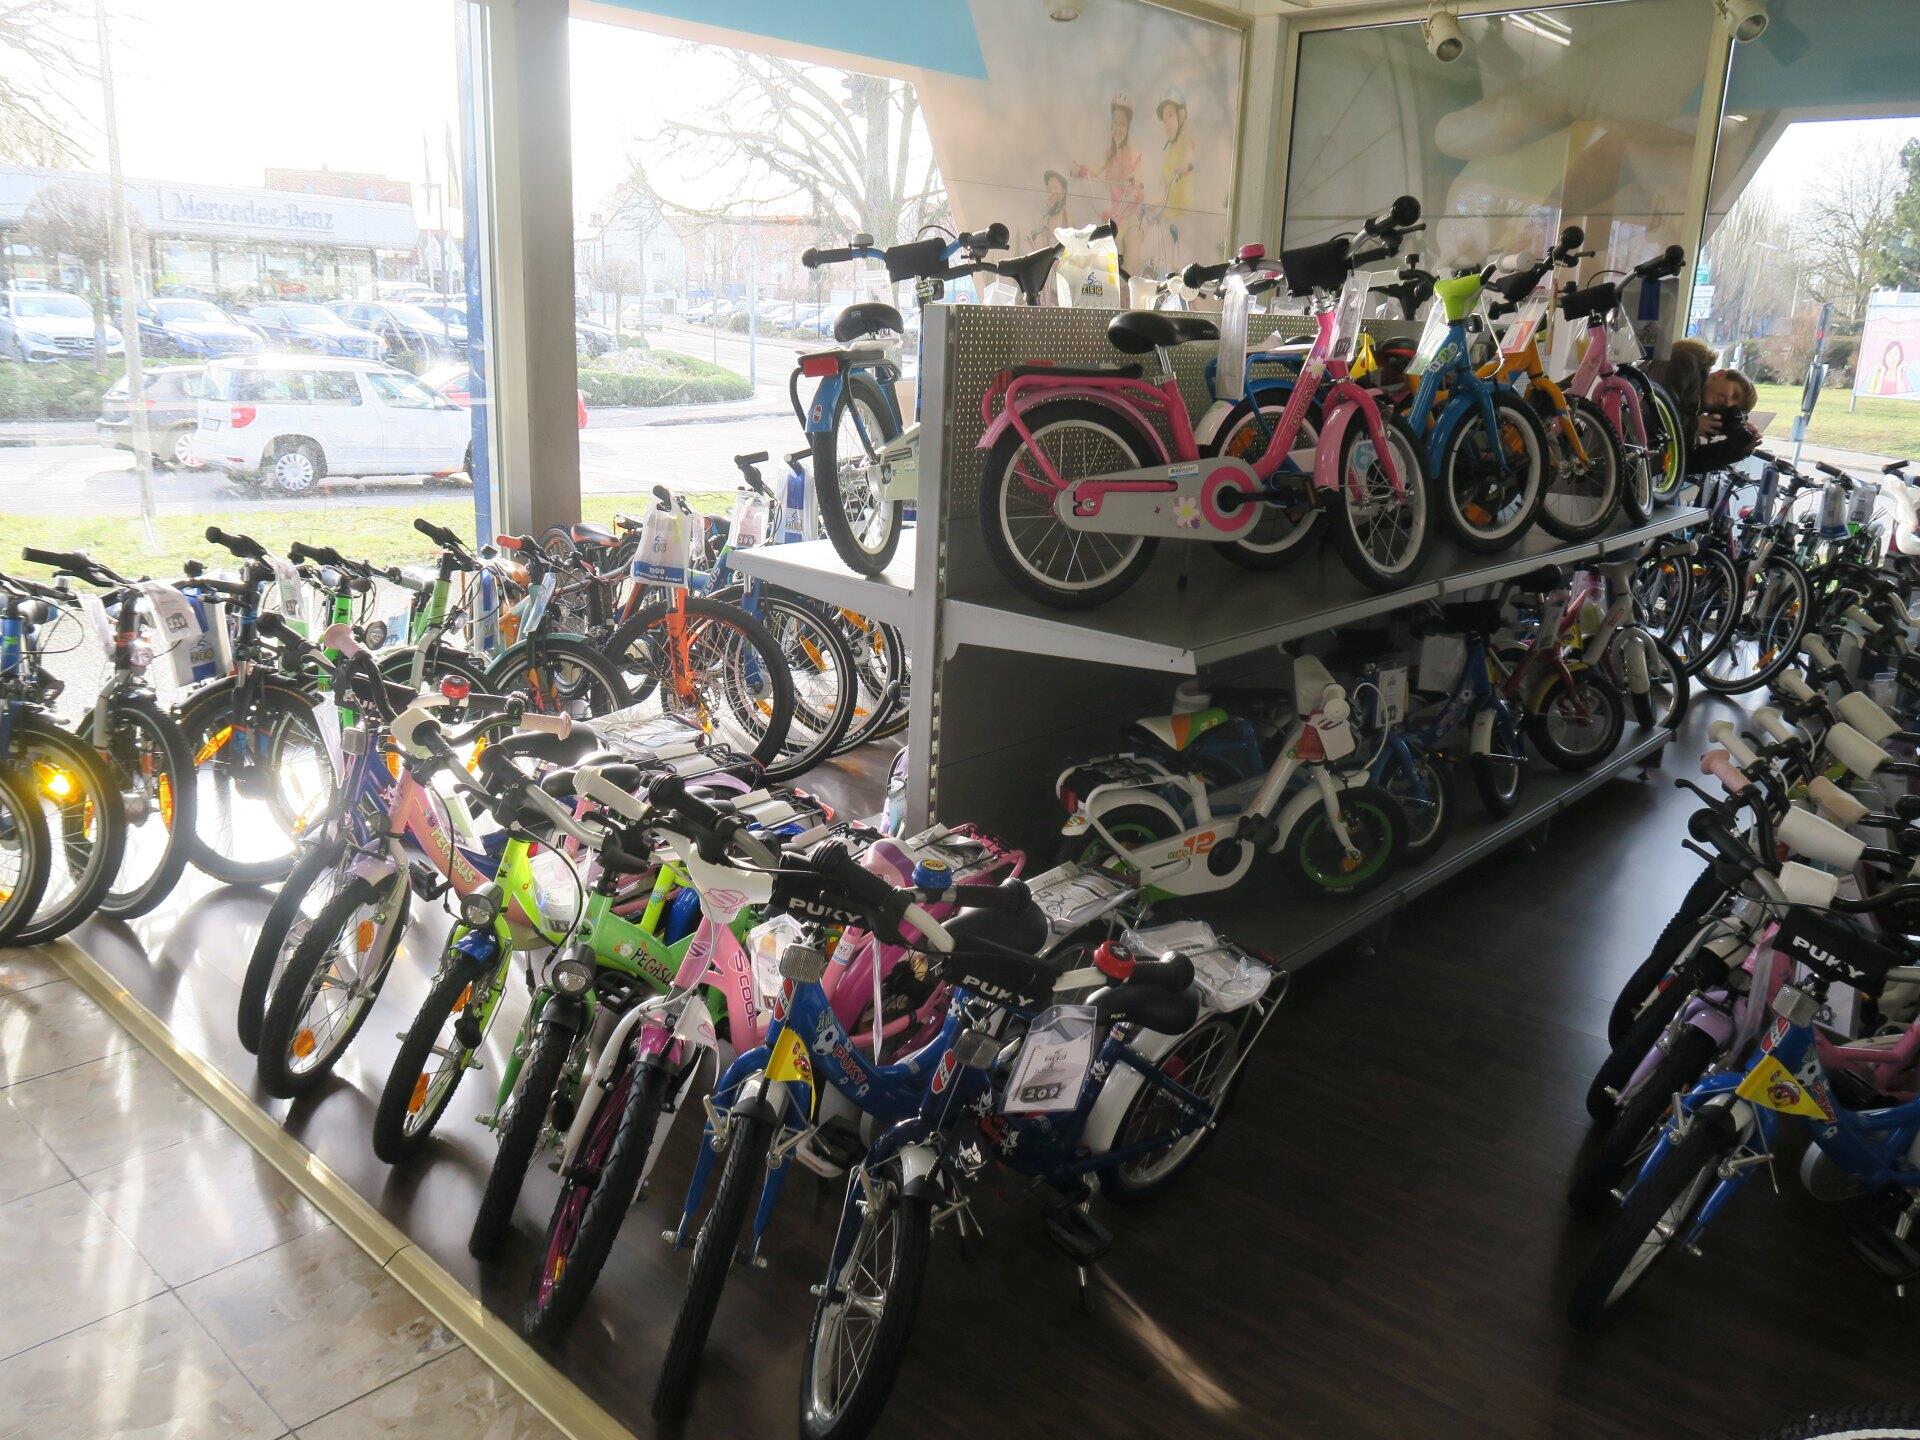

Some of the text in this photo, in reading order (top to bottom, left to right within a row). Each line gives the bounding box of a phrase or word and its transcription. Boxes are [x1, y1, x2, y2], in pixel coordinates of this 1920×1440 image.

[171, 192, 335, 231] Mercedes-Benz
[1183, 831, 1216, 856] 12
[788, 897, 862, 923] PUKY
[629, 946, 676, 987] PEGASU
[1791, 935, 1866, 979] PUKY
[961, 974, 1035, 1008] PUKY
[831, 1045, 868, 1086] PUKY
[1023, 1085, 1059, 1100] 209
